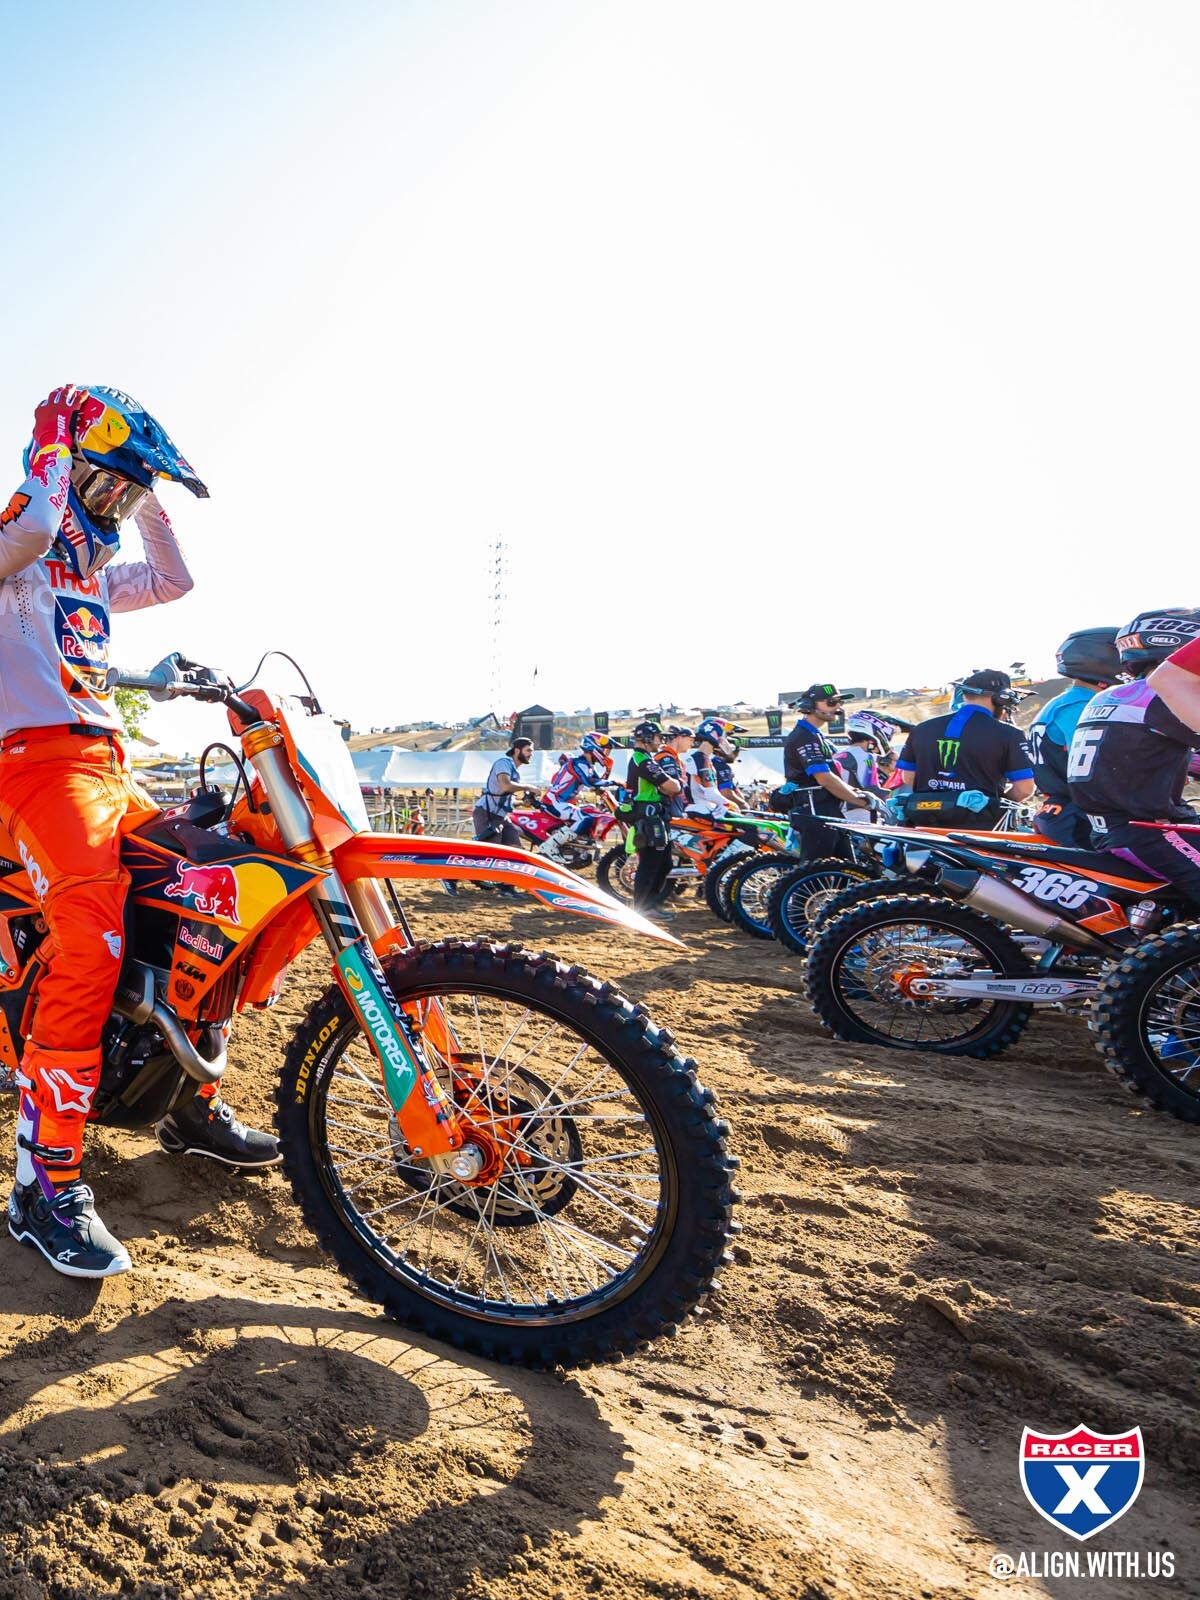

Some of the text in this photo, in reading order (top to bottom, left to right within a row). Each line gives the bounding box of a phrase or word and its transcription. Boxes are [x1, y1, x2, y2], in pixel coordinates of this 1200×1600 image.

[61, 504, 88, 547] Bull
[45, 560, 103, 598] THOR
[1150, 637, 1176, 645] BELL
[446, 854, 537, 876] Red Bull
[1012, 867, 1099, 909] 366
[179, 926, 224, 960] Red Bull
[175, 961, 207, 983] KTM
[356, 990, 413, 1078] MOTOREX
[295, 1016, 340, 1096] DUNLOP
